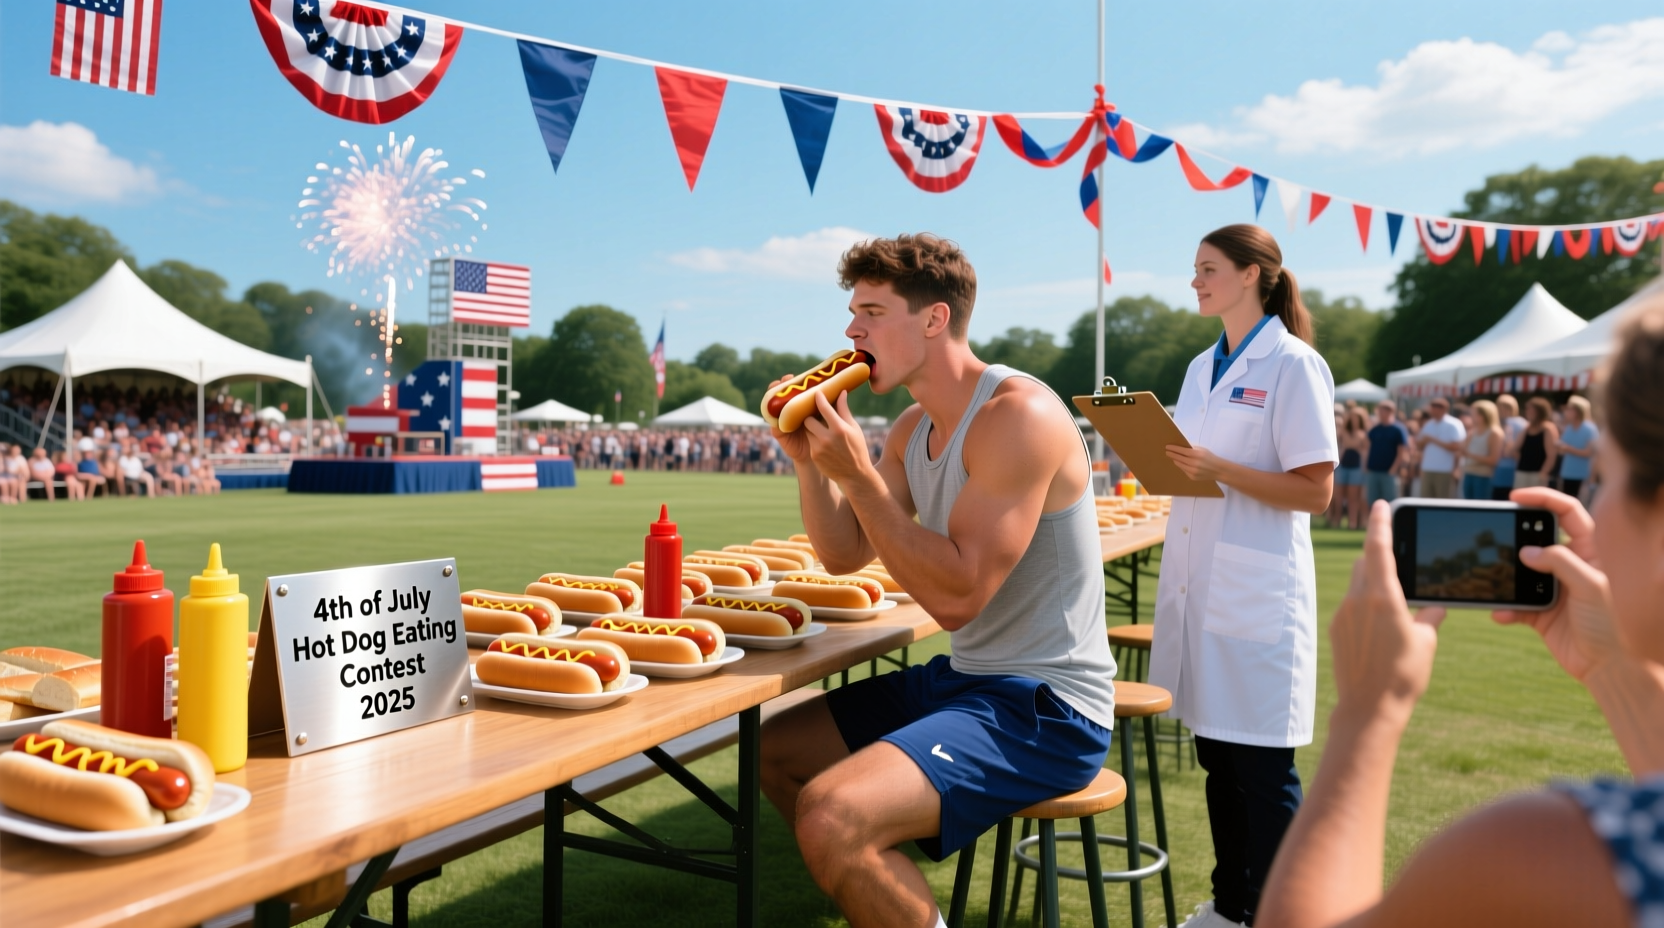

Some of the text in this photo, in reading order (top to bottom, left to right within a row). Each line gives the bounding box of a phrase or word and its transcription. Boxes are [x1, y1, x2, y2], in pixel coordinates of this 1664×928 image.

[313, 585, 432, 622] 4th of July
[292, 616, 457, 662] Hot Dog Eating
[339, 652, 427, 688] Contest
[360, 685, 416, 720] 2025
